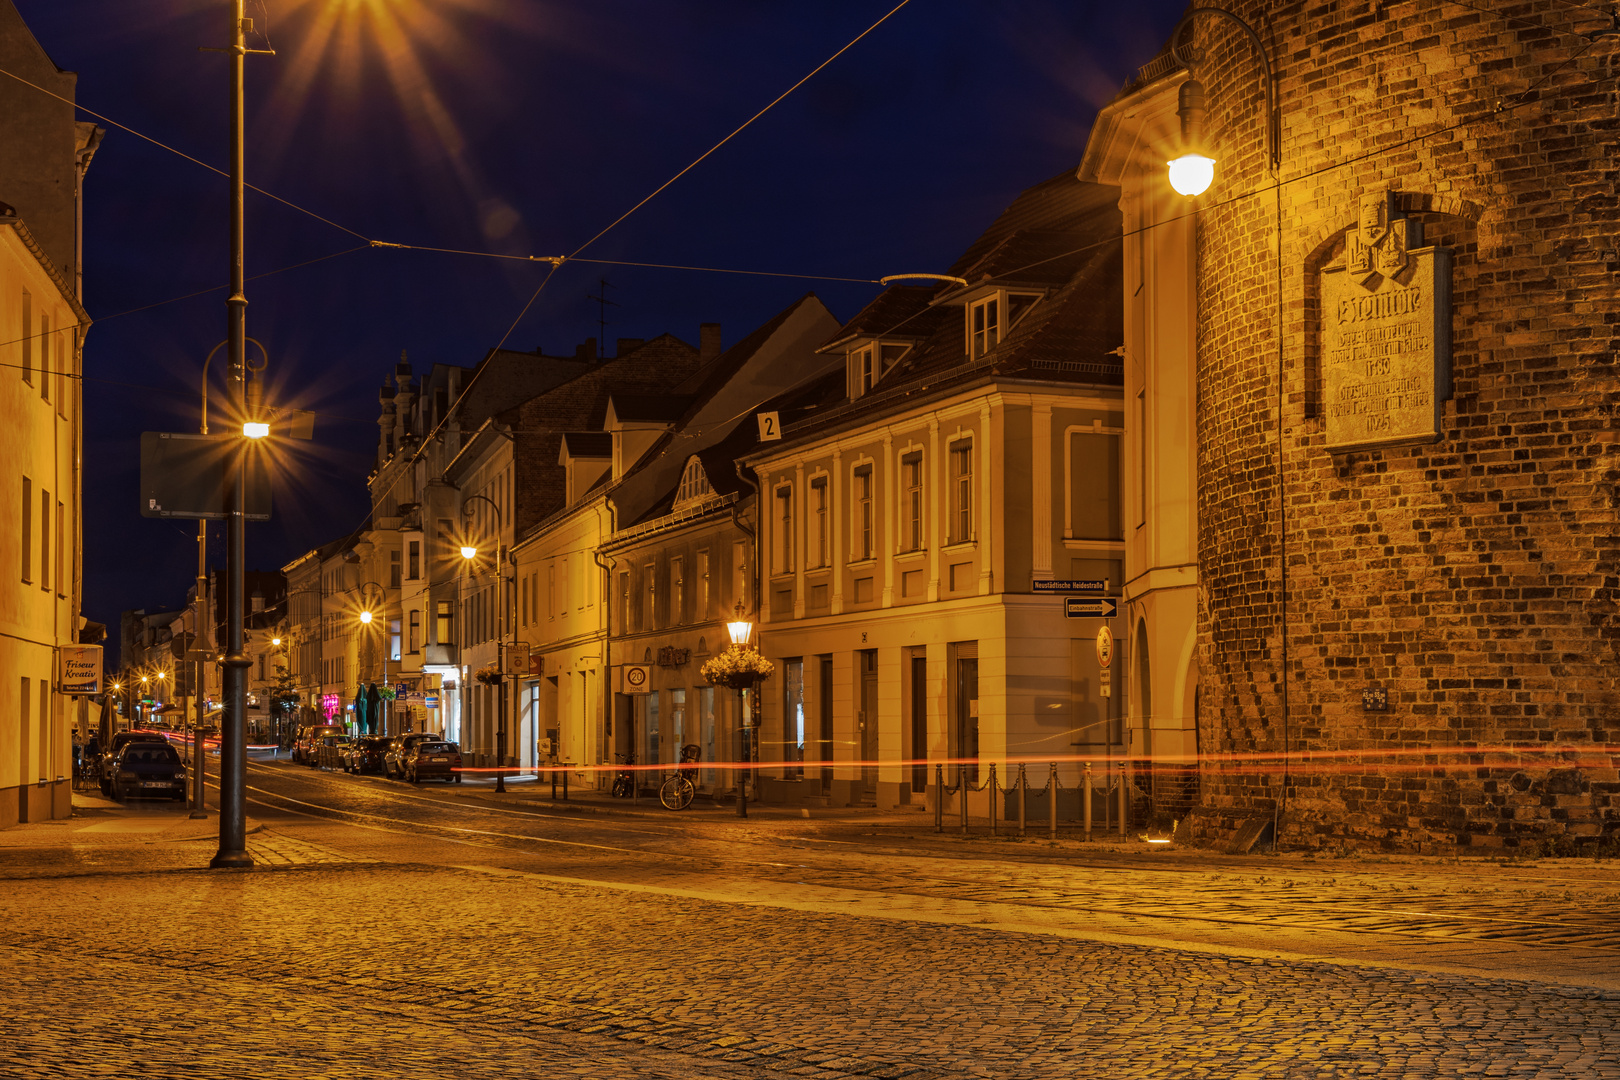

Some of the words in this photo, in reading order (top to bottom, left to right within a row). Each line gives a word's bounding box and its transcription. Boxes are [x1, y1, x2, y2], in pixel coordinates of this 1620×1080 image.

[1337, 287, 1421, 325] Steintor
[764, 417, 775, 436] 2
[1366, 413, 1391, 432] 1925
[1034, 581, 1071, 589] Neustädtische
[1072, 581, 1103, 589] Heidestraße
[65, 659, 96, 669] Friseur
[64, 669, 96, 679] Kreativ
[632, 672, 643, 681] 20
